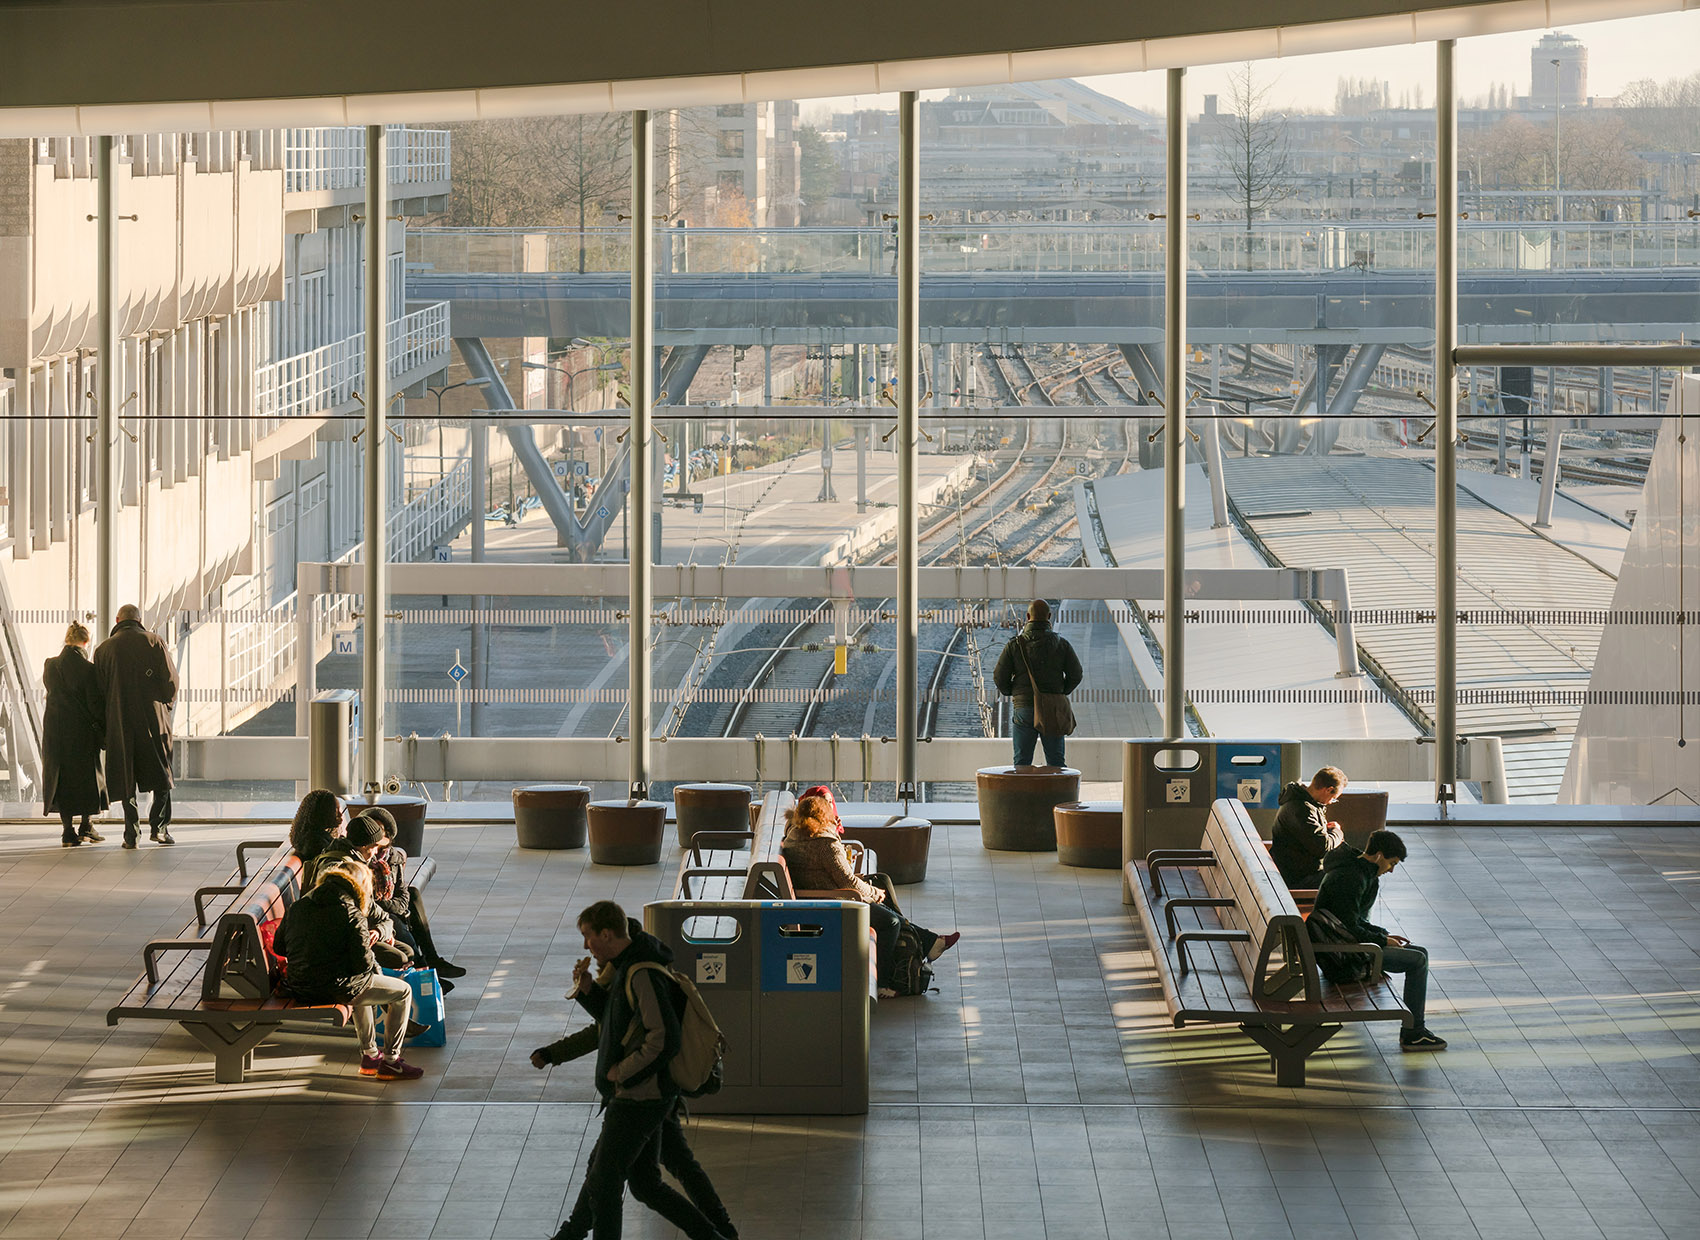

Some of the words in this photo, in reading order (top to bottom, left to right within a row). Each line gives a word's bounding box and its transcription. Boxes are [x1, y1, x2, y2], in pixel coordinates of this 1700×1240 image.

[1079, 462, 1086, 473] 8
[439, 552, 447, 560] N
[340, 641, 352, 652] M
[454, 669, 460, 677] 6
